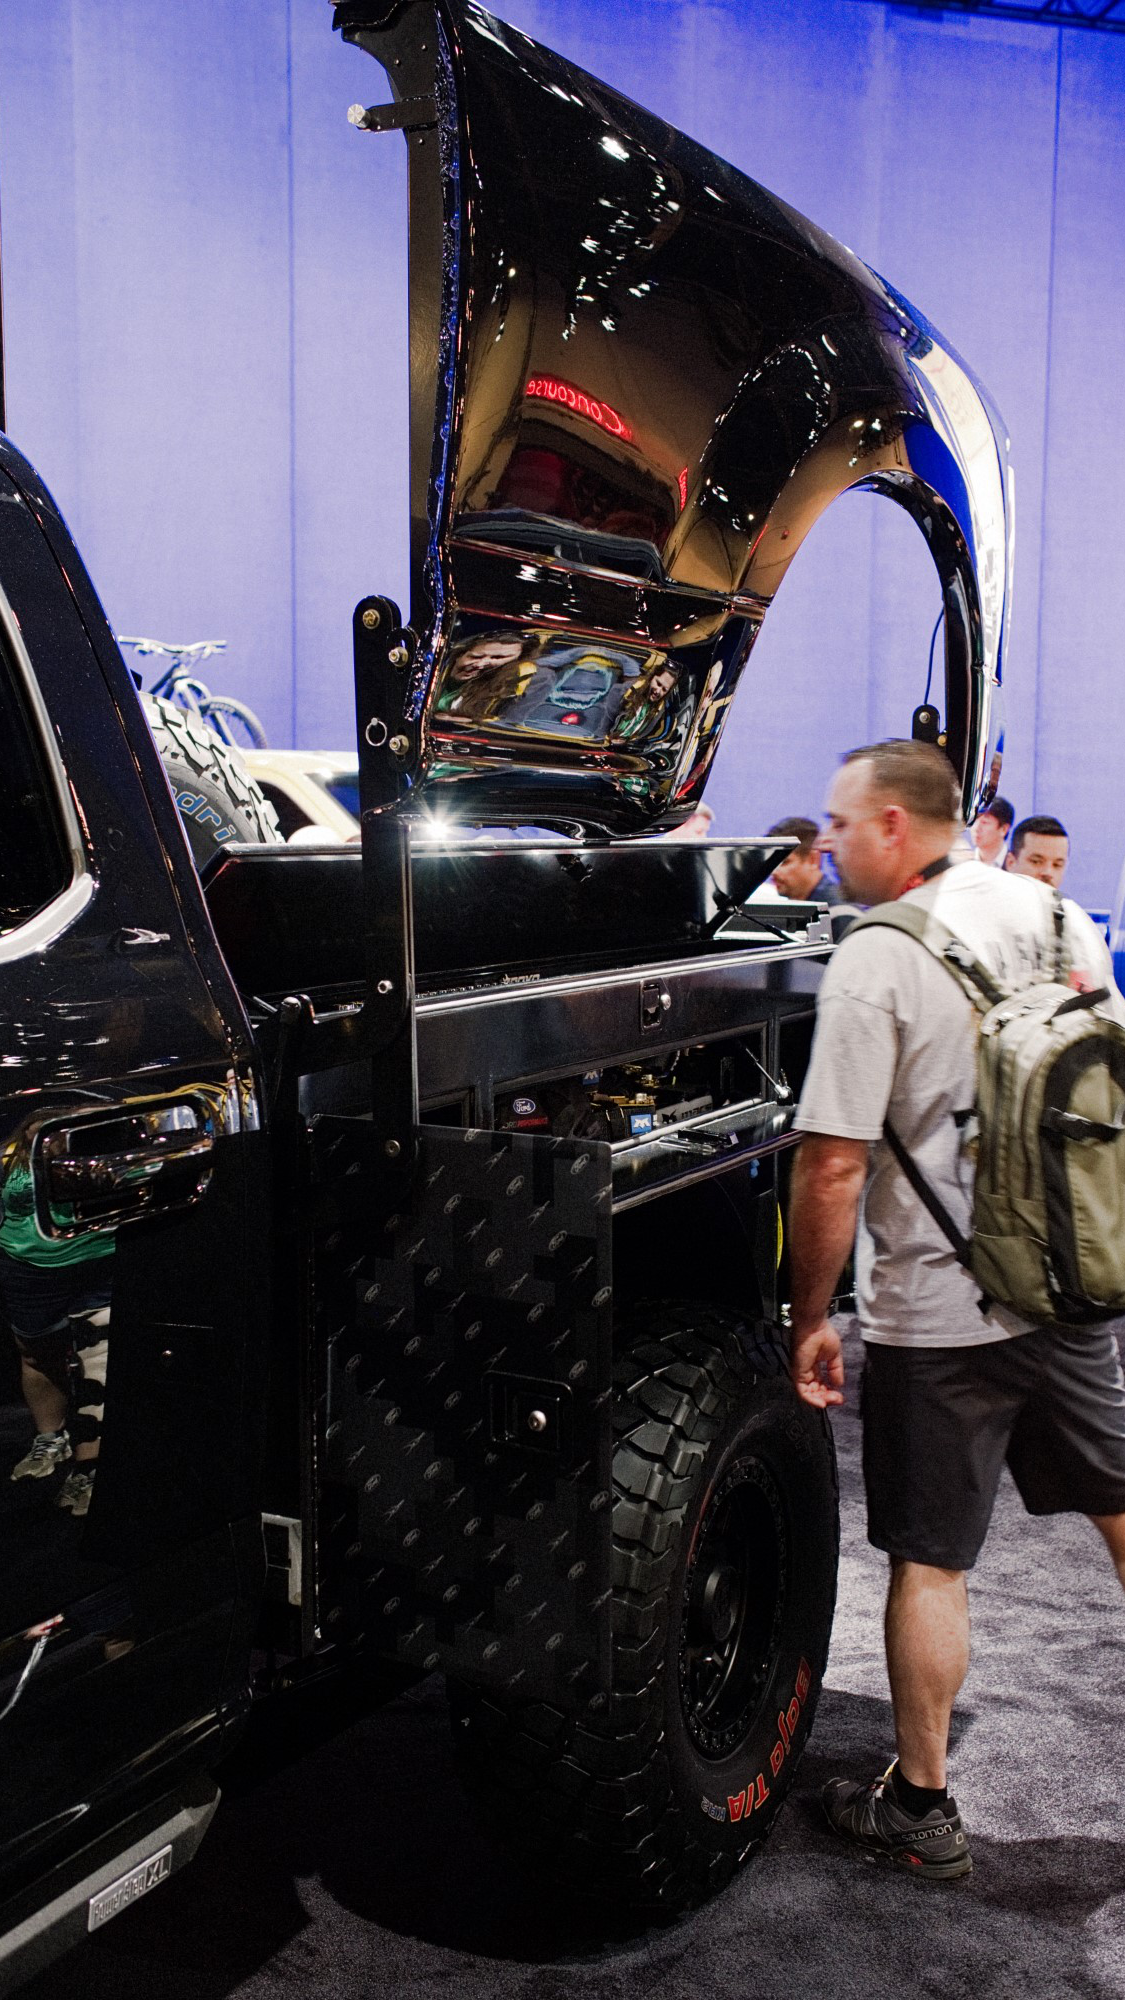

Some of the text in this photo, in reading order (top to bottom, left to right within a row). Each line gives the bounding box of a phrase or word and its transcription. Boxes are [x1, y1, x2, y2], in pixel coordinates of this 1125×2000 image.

[514, 1099, 534, 1113] Ford
[770, 1656, 812, 1777] Baja
[727, 1772, 770, 1823] T/A
[146, 1857, 169, 1888] XL
